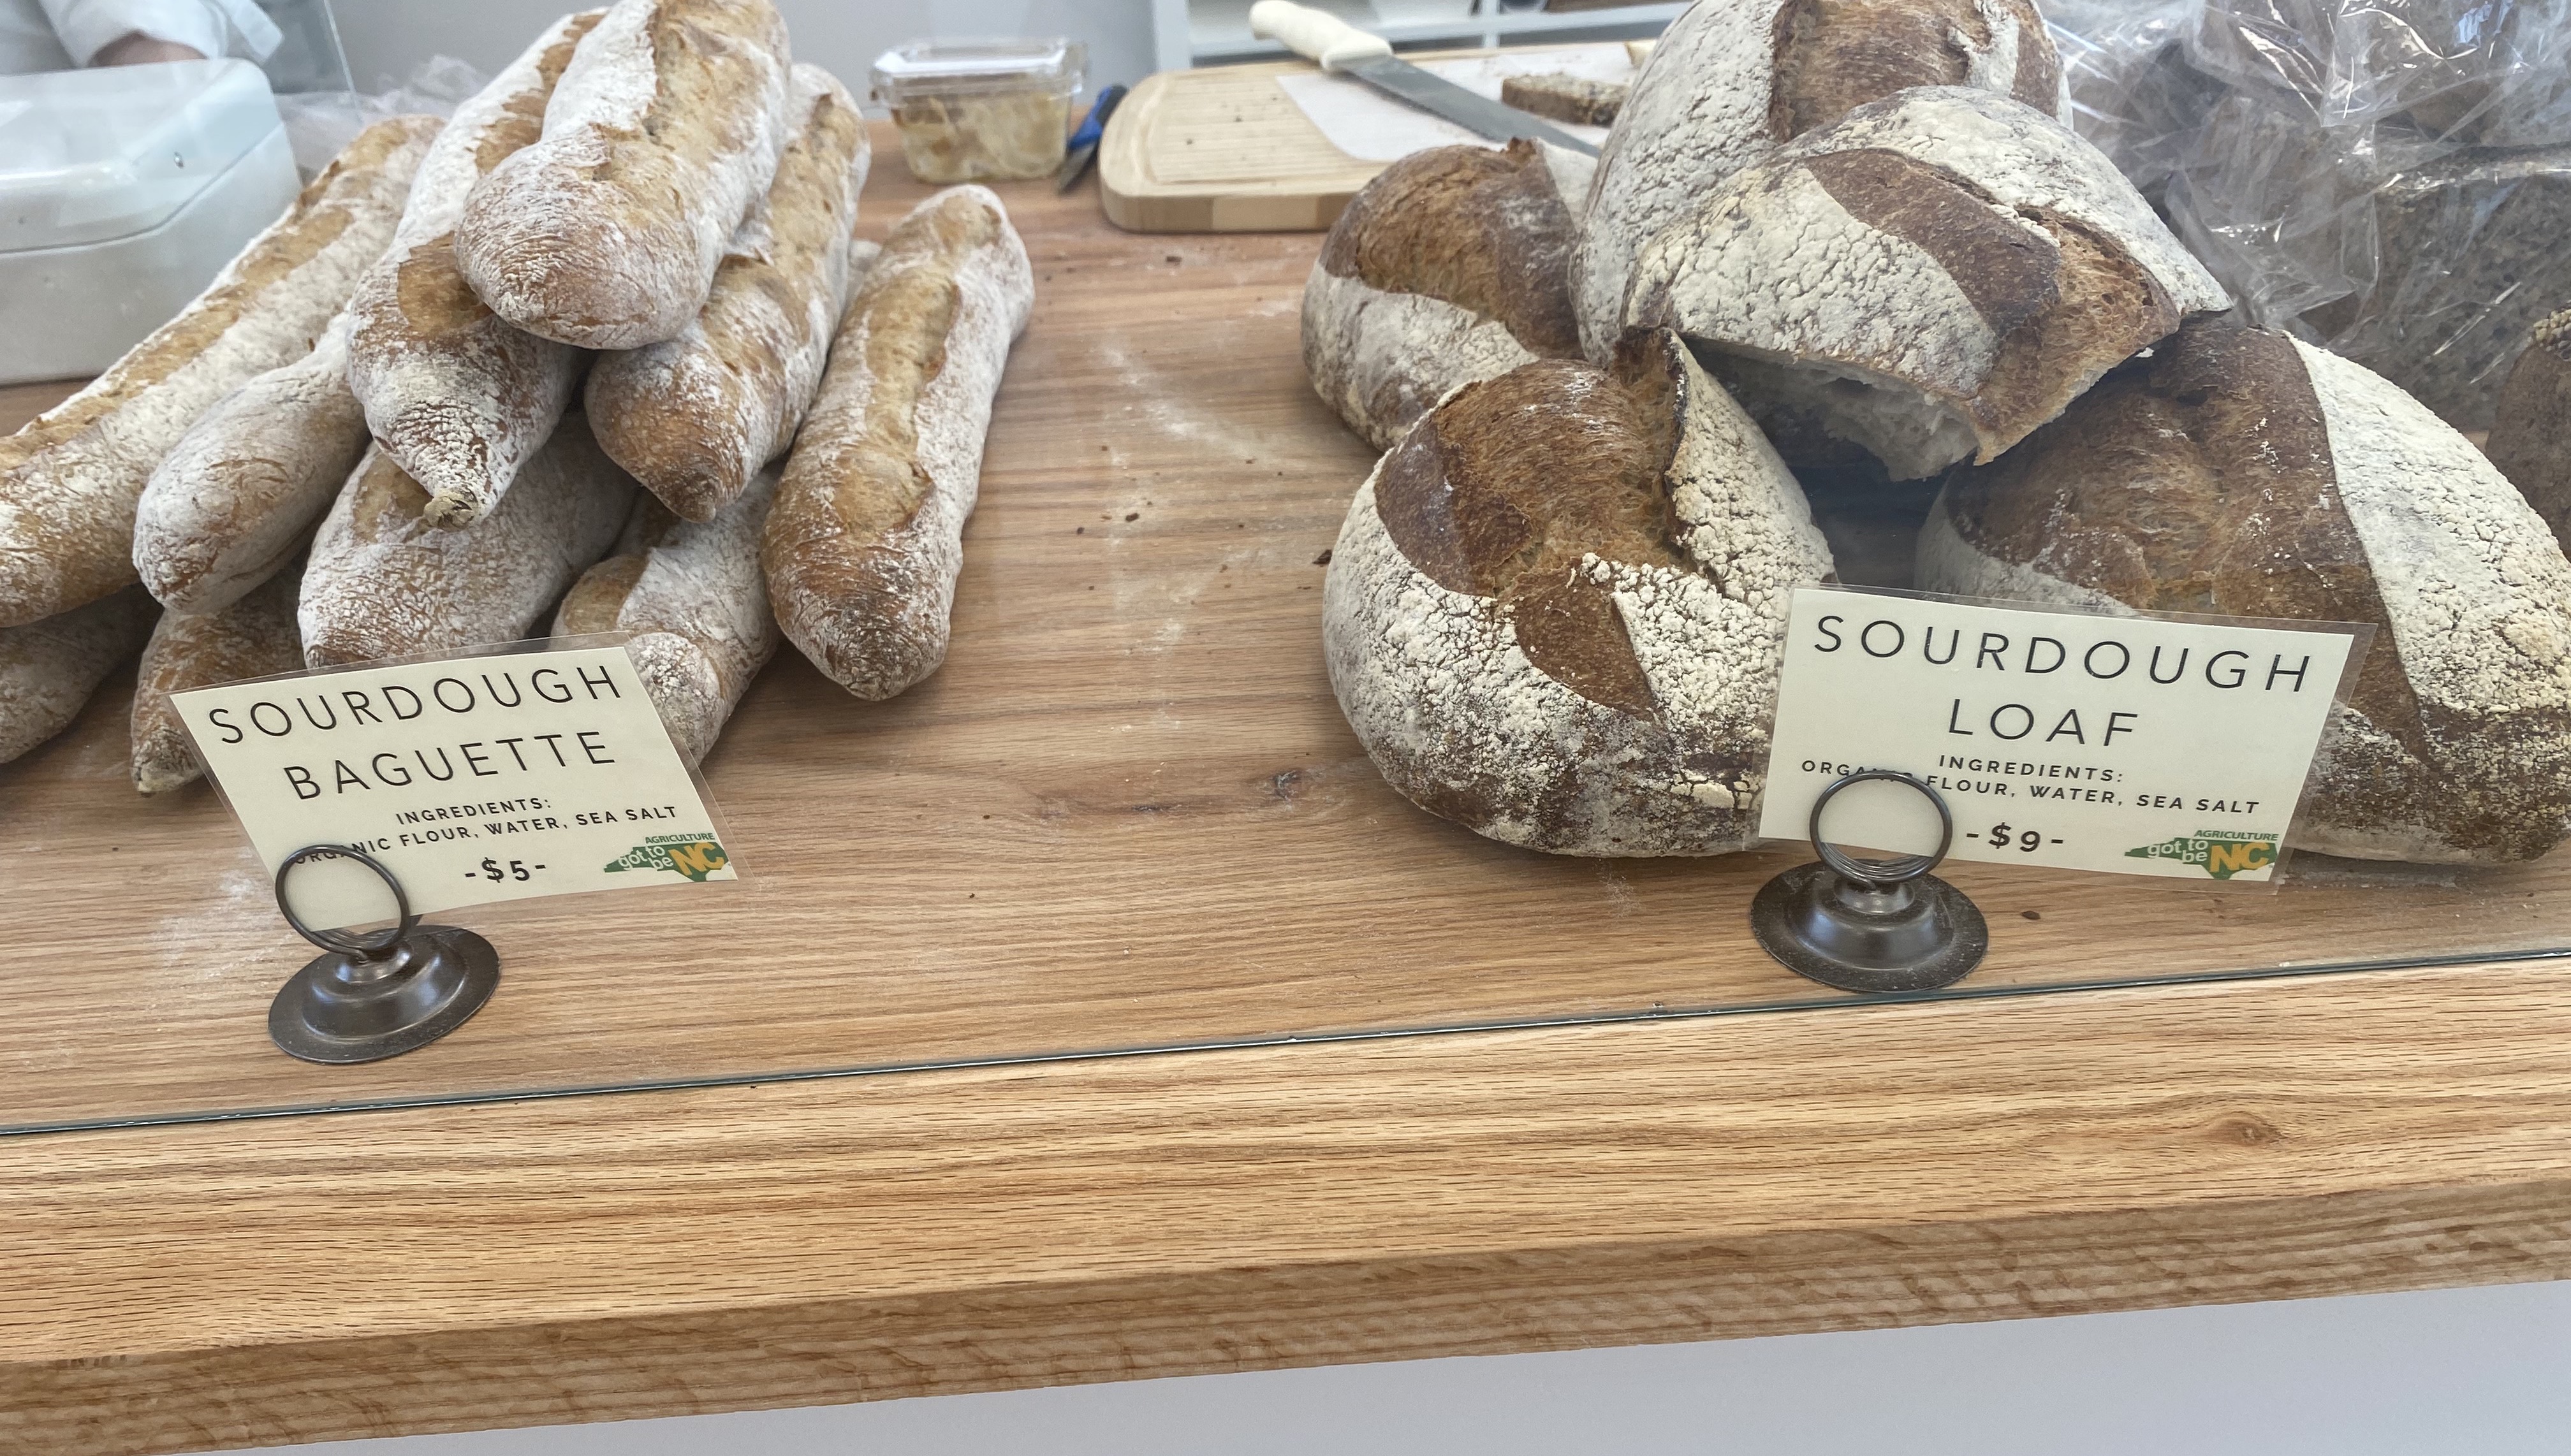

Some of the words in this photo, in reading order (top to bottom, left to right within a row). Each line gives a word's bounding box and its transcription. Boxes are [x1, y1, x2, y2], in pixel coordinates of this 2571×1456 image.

[1813, 615, 2312, 693] SOURDOUGH
[209, 665, 622, 744] SOURDOUGH
[1948, 698, 2139, 747] LOAF
[283, 731, 616, 800] BAGUETTE
[1938, 755, 2123, 783] INGREDIENTS:
[1926, 775, 2016, 798] FLOUR,
[2030, 785, 2123, 807] WATER,
[2136, 794, 2183, 810] SEA
[2195, 799, 2260, 814] SALT
[395, 797, 552, 825] INGREDIENTS:
[399, 826, 479, 847] FLOUR,
[484, 817, 568, 835] WATER,
[575, 810, 619, 826] SEA
[625, 806, 677, 821] SALT
[645, 833, 715, 845] AGRICULTURE
[1966, 822, 2064, 852] -$9-
[2146, 840, 2183, 859] got
[2187, 838, 2209, 852] to
[2194, 829, 2280, 841] AGRICULTURE
[465, 857, 546, 884] -$5-
[618, 848, 648, 871] got
[645, 845, 666, 859] to
[647, 855, 674, 871] be
[668, 841, 725, 877] NC
[2182, 850, 2208, 863] be
[2209, 841, 2270, 873] NC
